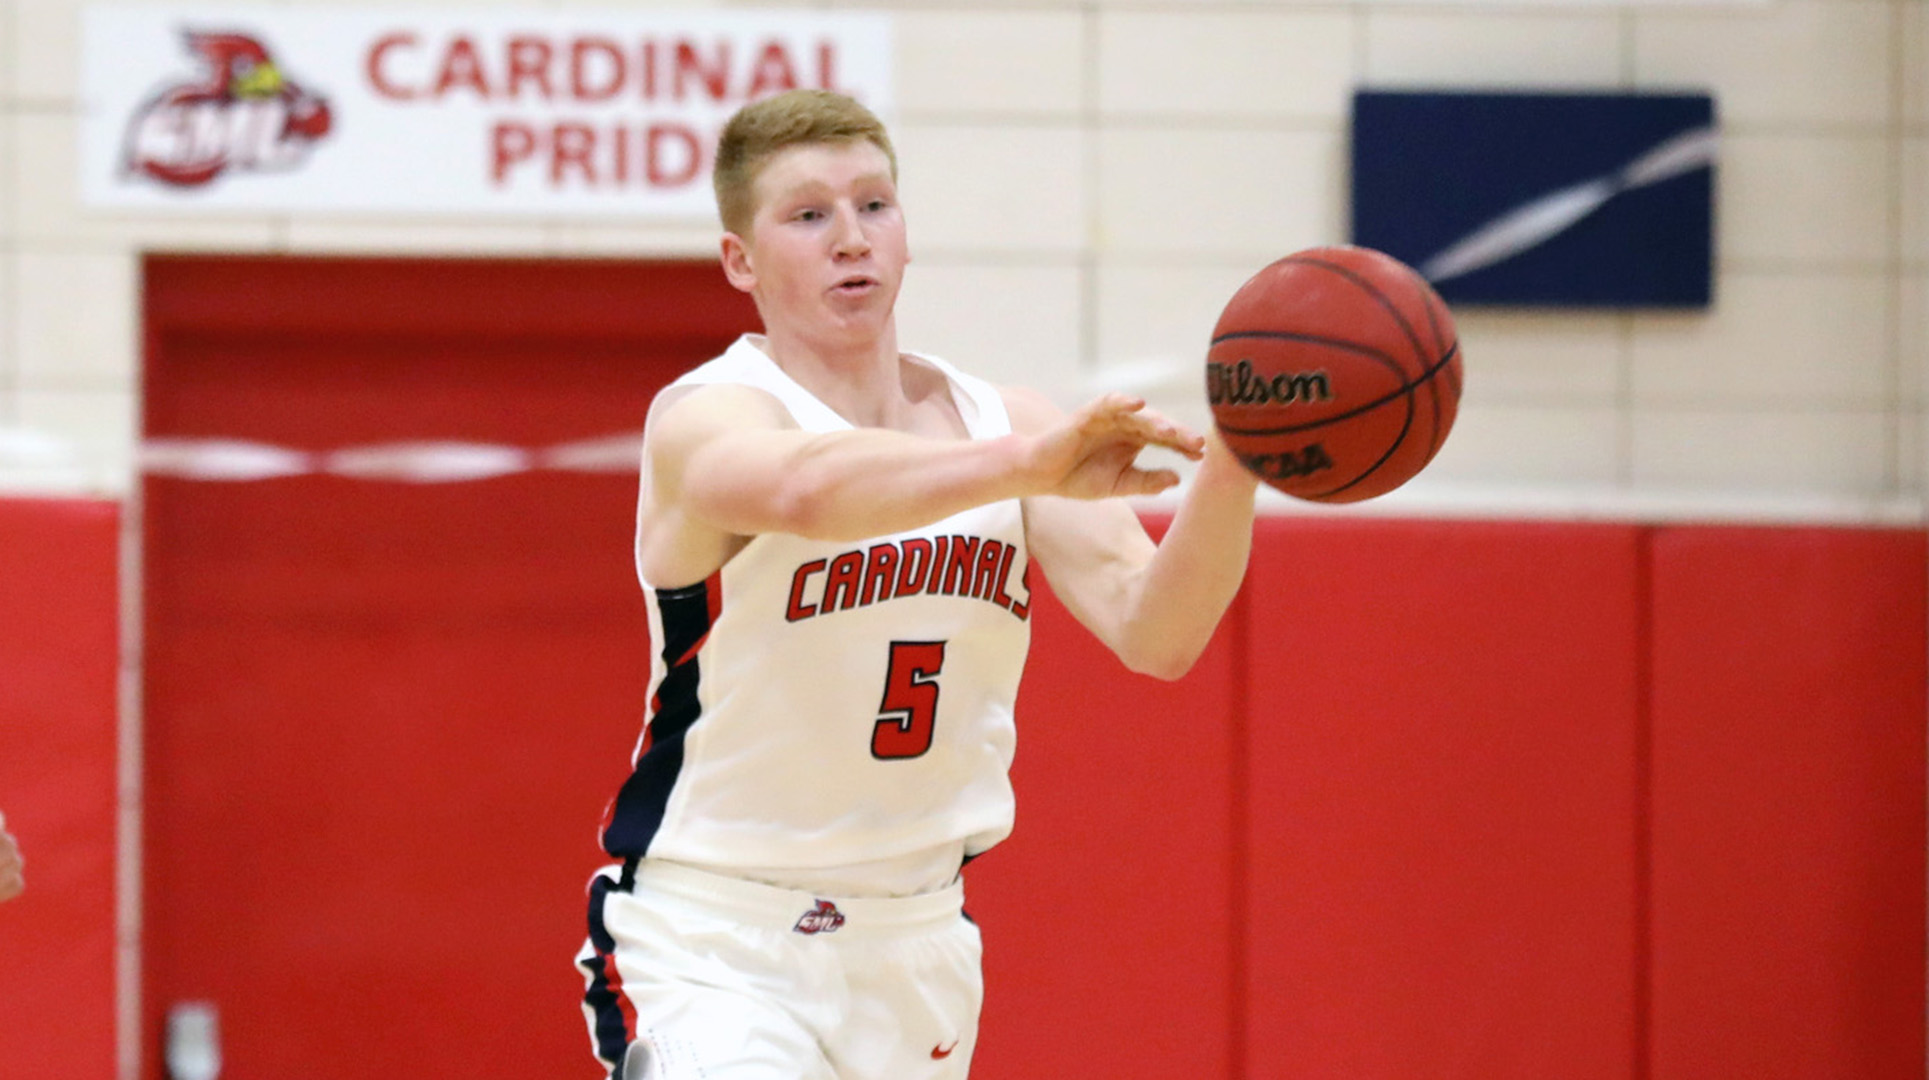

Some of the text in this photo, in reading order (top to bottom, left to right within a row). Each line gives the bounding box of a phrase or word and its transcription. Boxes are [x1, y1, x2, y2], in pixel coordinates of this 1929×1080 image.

[366, 33, 850, 101] CARDINAL
[489, 119, 715, 188] PRID
[1236, 442, 1333, 479] CAA
[870, 639, 948, 761] 5
